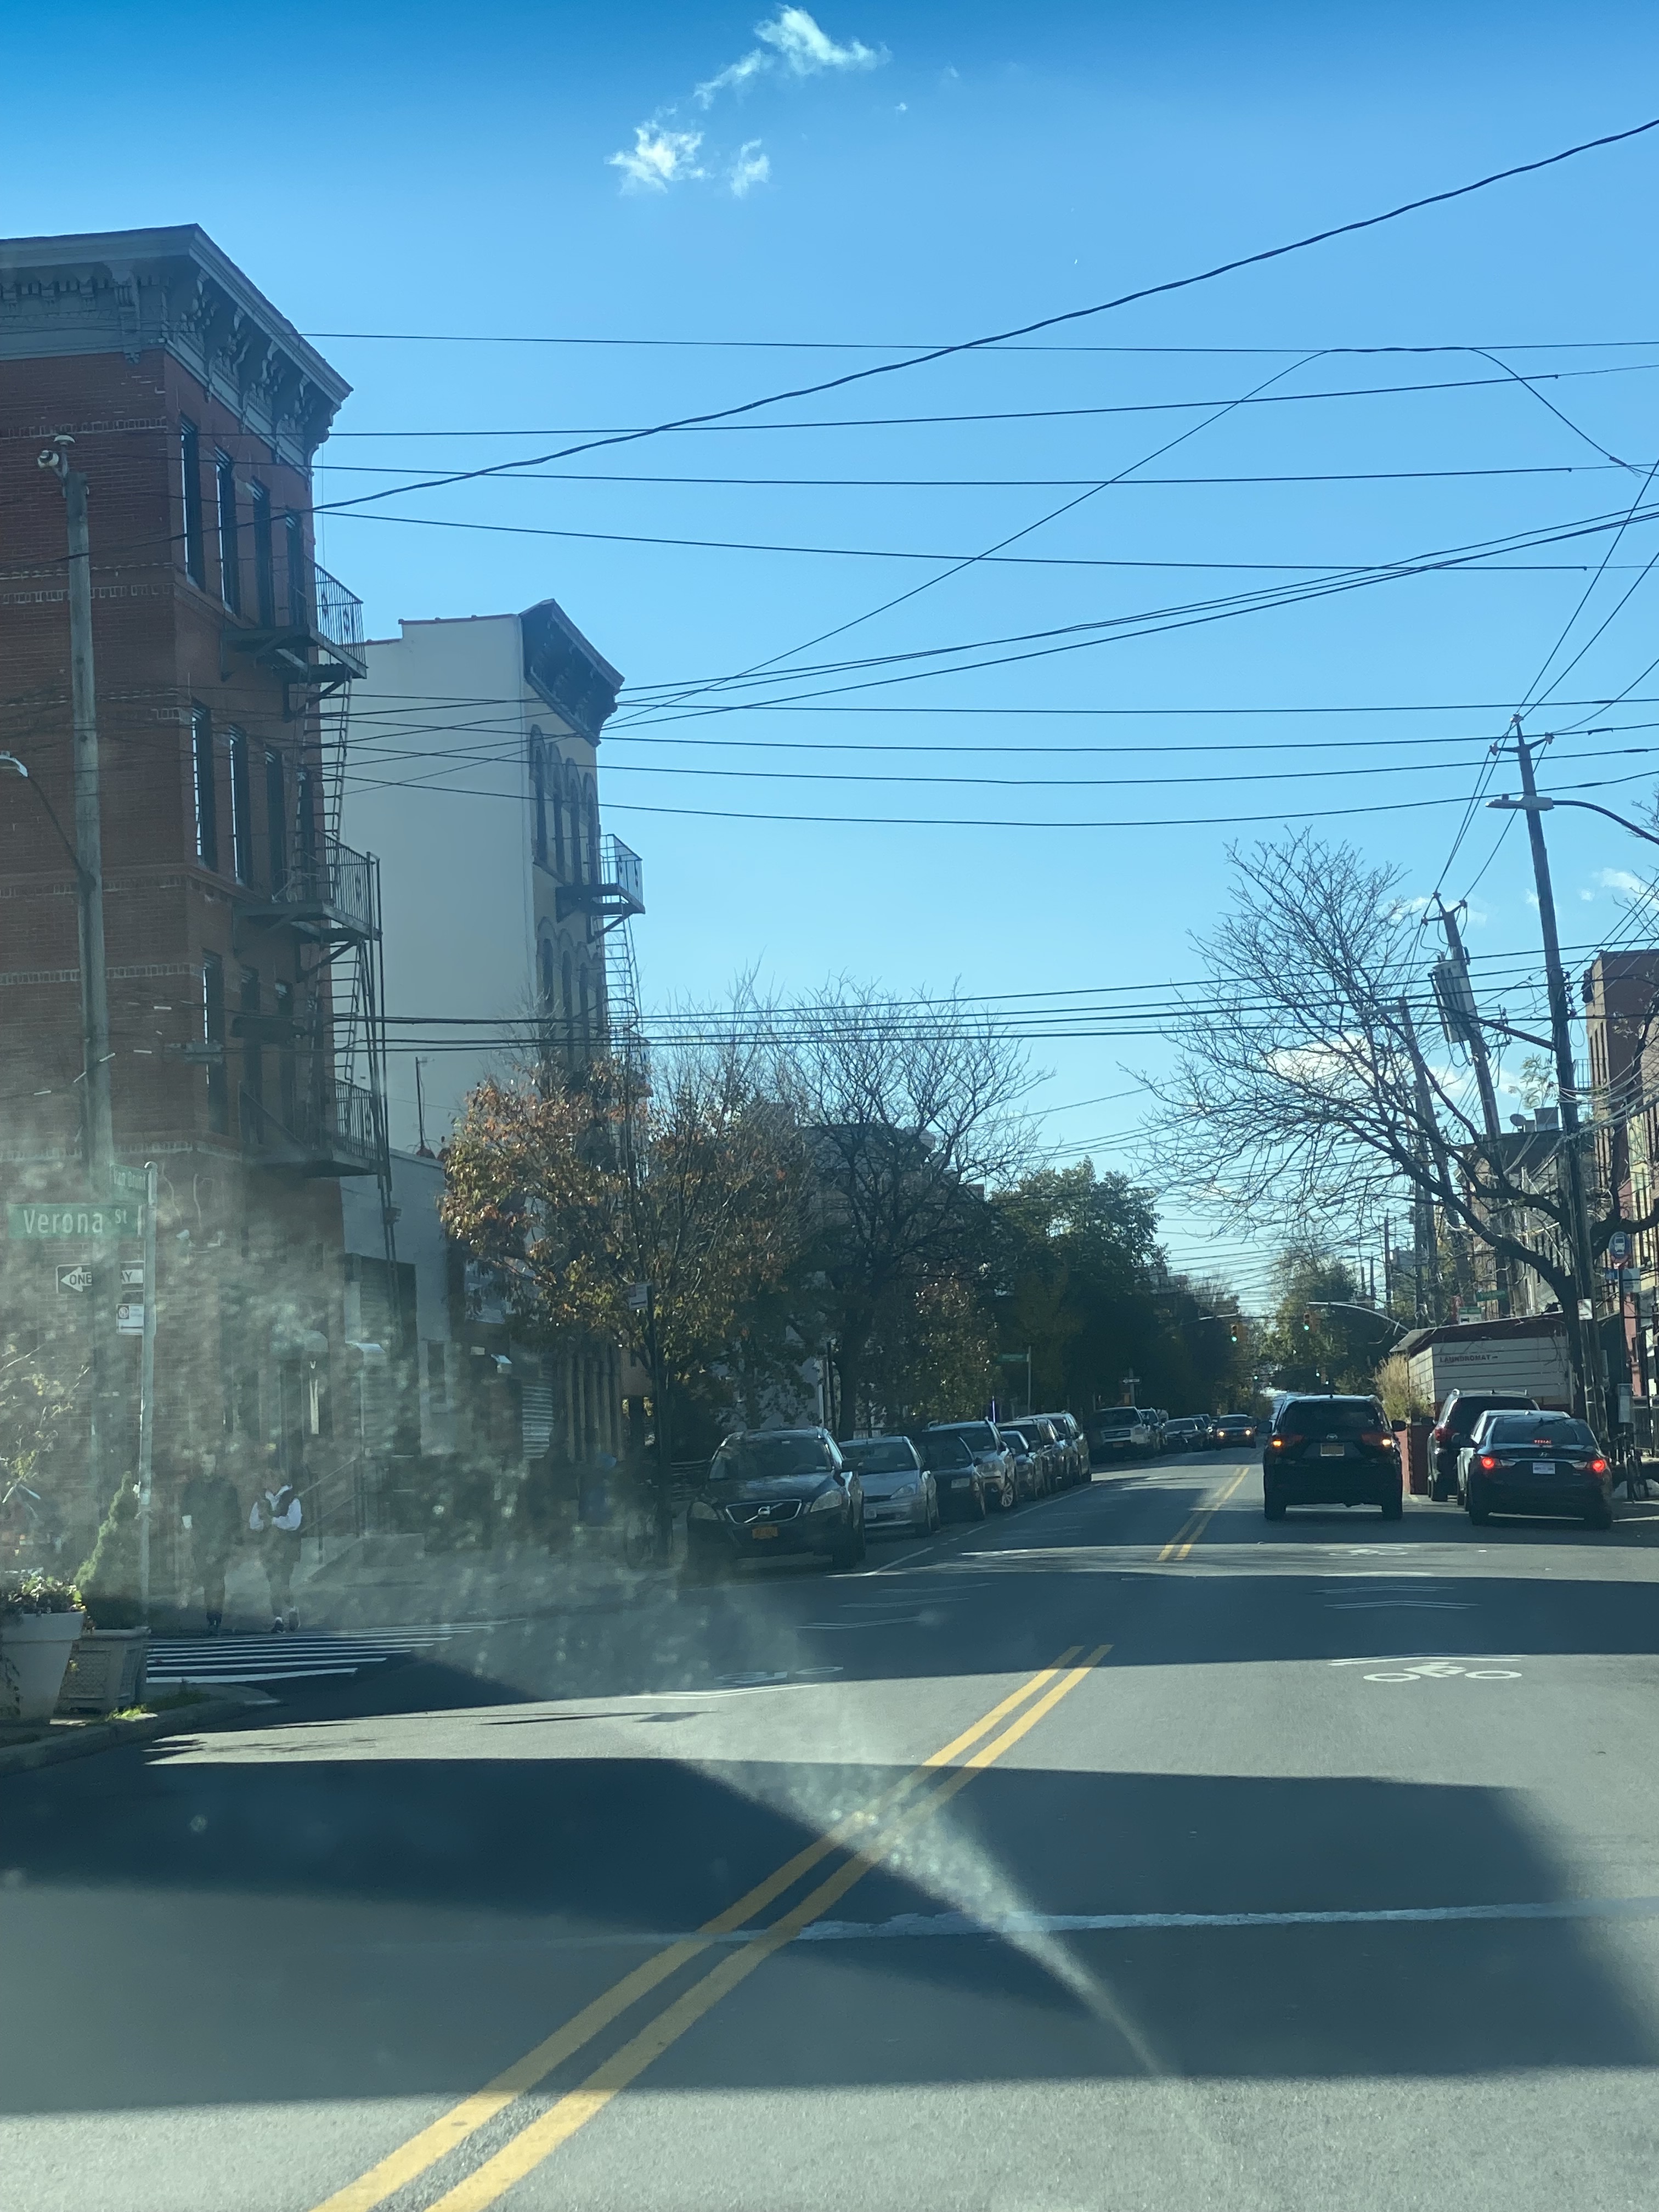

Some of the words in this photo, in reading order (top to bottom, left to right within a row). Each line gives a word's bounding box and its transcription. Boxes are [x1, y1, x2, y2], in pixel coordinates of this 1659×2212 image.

[23, 1209, 103, 1234] Verona
[115, 1209, 127, 1224] St
[69, 1273, 93, 1285] ONE
[1440, 1354, 1491, 1363] LAUNDROMAT
